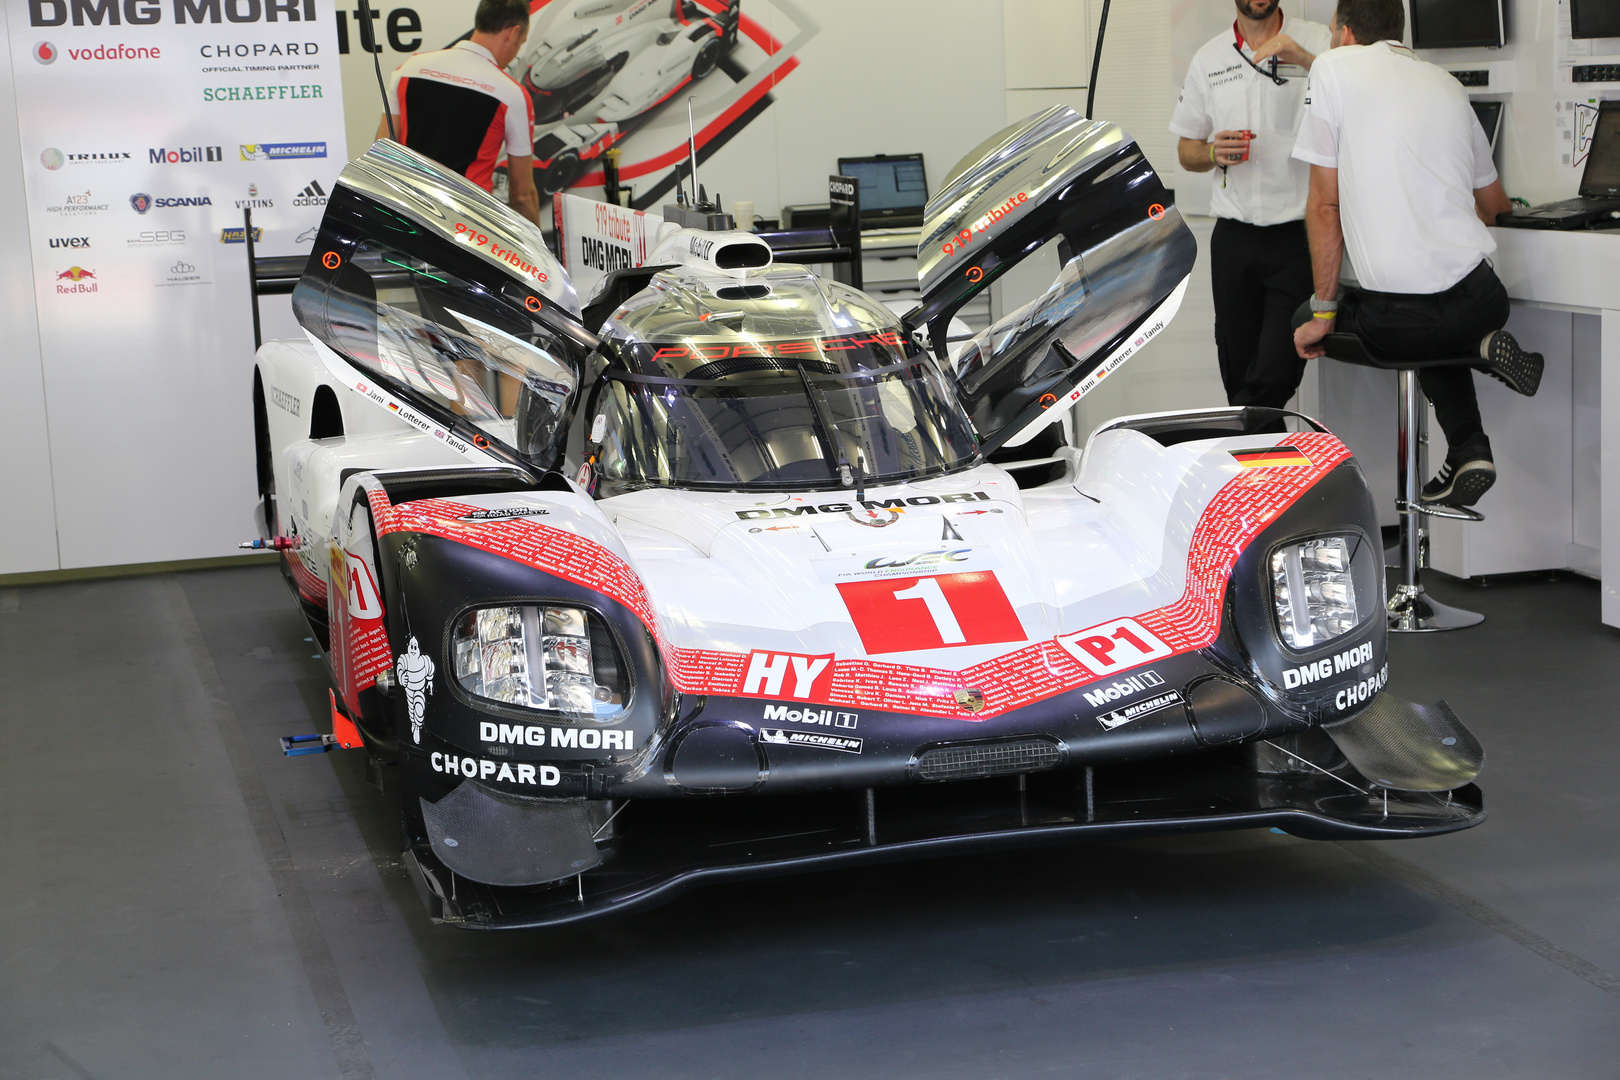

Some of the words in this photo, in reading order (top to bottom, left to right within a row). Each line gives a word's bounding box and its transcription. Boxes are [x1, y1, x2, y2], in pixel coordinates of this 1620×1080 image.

[28, 0, 161, 27] DMG
[173, 0, 317, 24] MORI
[68, 44, 161, 60] vodafone
[200, 42, 319, 58] CHOPARD
[419, 68, 496, 92] PORSCHE
[203, 85, 324, 102] SCHAEFFLER
[66, 152, 132, 160] TRILUX
[149, 146, 202, 164] Mobil
[269, 146, 326, 155] MICHELIN
[830, 181, 854, 195] CHOPARD
[64, 204, 110, 212] PERFORMANCE
[66, 195, 88, 204] A123
[155, 196, 212, 208] SCANIA
[292, 196, 328, 206] adida
[596, 203, 608, 236] 919
[608, 208, 630, 243] tribute
[942, 228, 973, 258] 919
[974, 191, 1028, 234] tribute
[48, 237, 90, 248] uvex
[140, 230, 186, 242] SBG
[224, 231, 258, 240] HAZT
[455, 222, 489, 248] 919
[490, 242, 548, 284] tribute
[582, 236, 604, 271] DMG
[56, 284, 77, 294] Red
[78, 284, 98, 292] Bull
[651, 332, 908, 362] PORSCHE
[1080, 378, 1096, 394] Jani
[1105, 346, 1133, 372] Lotterer
[1143, 320, 1164, 340] Tandy
[366, 390, 385, 404] Jani
[398, 408, 431, 431] Lotterer
[445, 434, 469, 454] Tandy
[488, 507, 528, 516] ACTION
[736, 502, 852, 521] DMG
[861, 492, 991, 510] MORI
[874, 569, 938, 578] CHAMPIONSHIP
[884, 566, 938, 574] ENDURANCE
[892, 578, 966, 644] 1
[1074, 626, 1155, 667] P1
[1282, 659, 1332, 690] DMG
[1334, 640, 1374, 674] MORI
[742, 652, 832, 699] HY
[1082, 678, 1146, 708] Mobil
[1124, 692, 1178, 717] MICHELIN
[763, 705, 832, 726] Mobil
[480, 722, 546, 746] DMG
[551, 728, 634, 750] MORI
[790, 733, 860, 750] MICHELIN
[430, 752, 561, 786] CHOPARD
